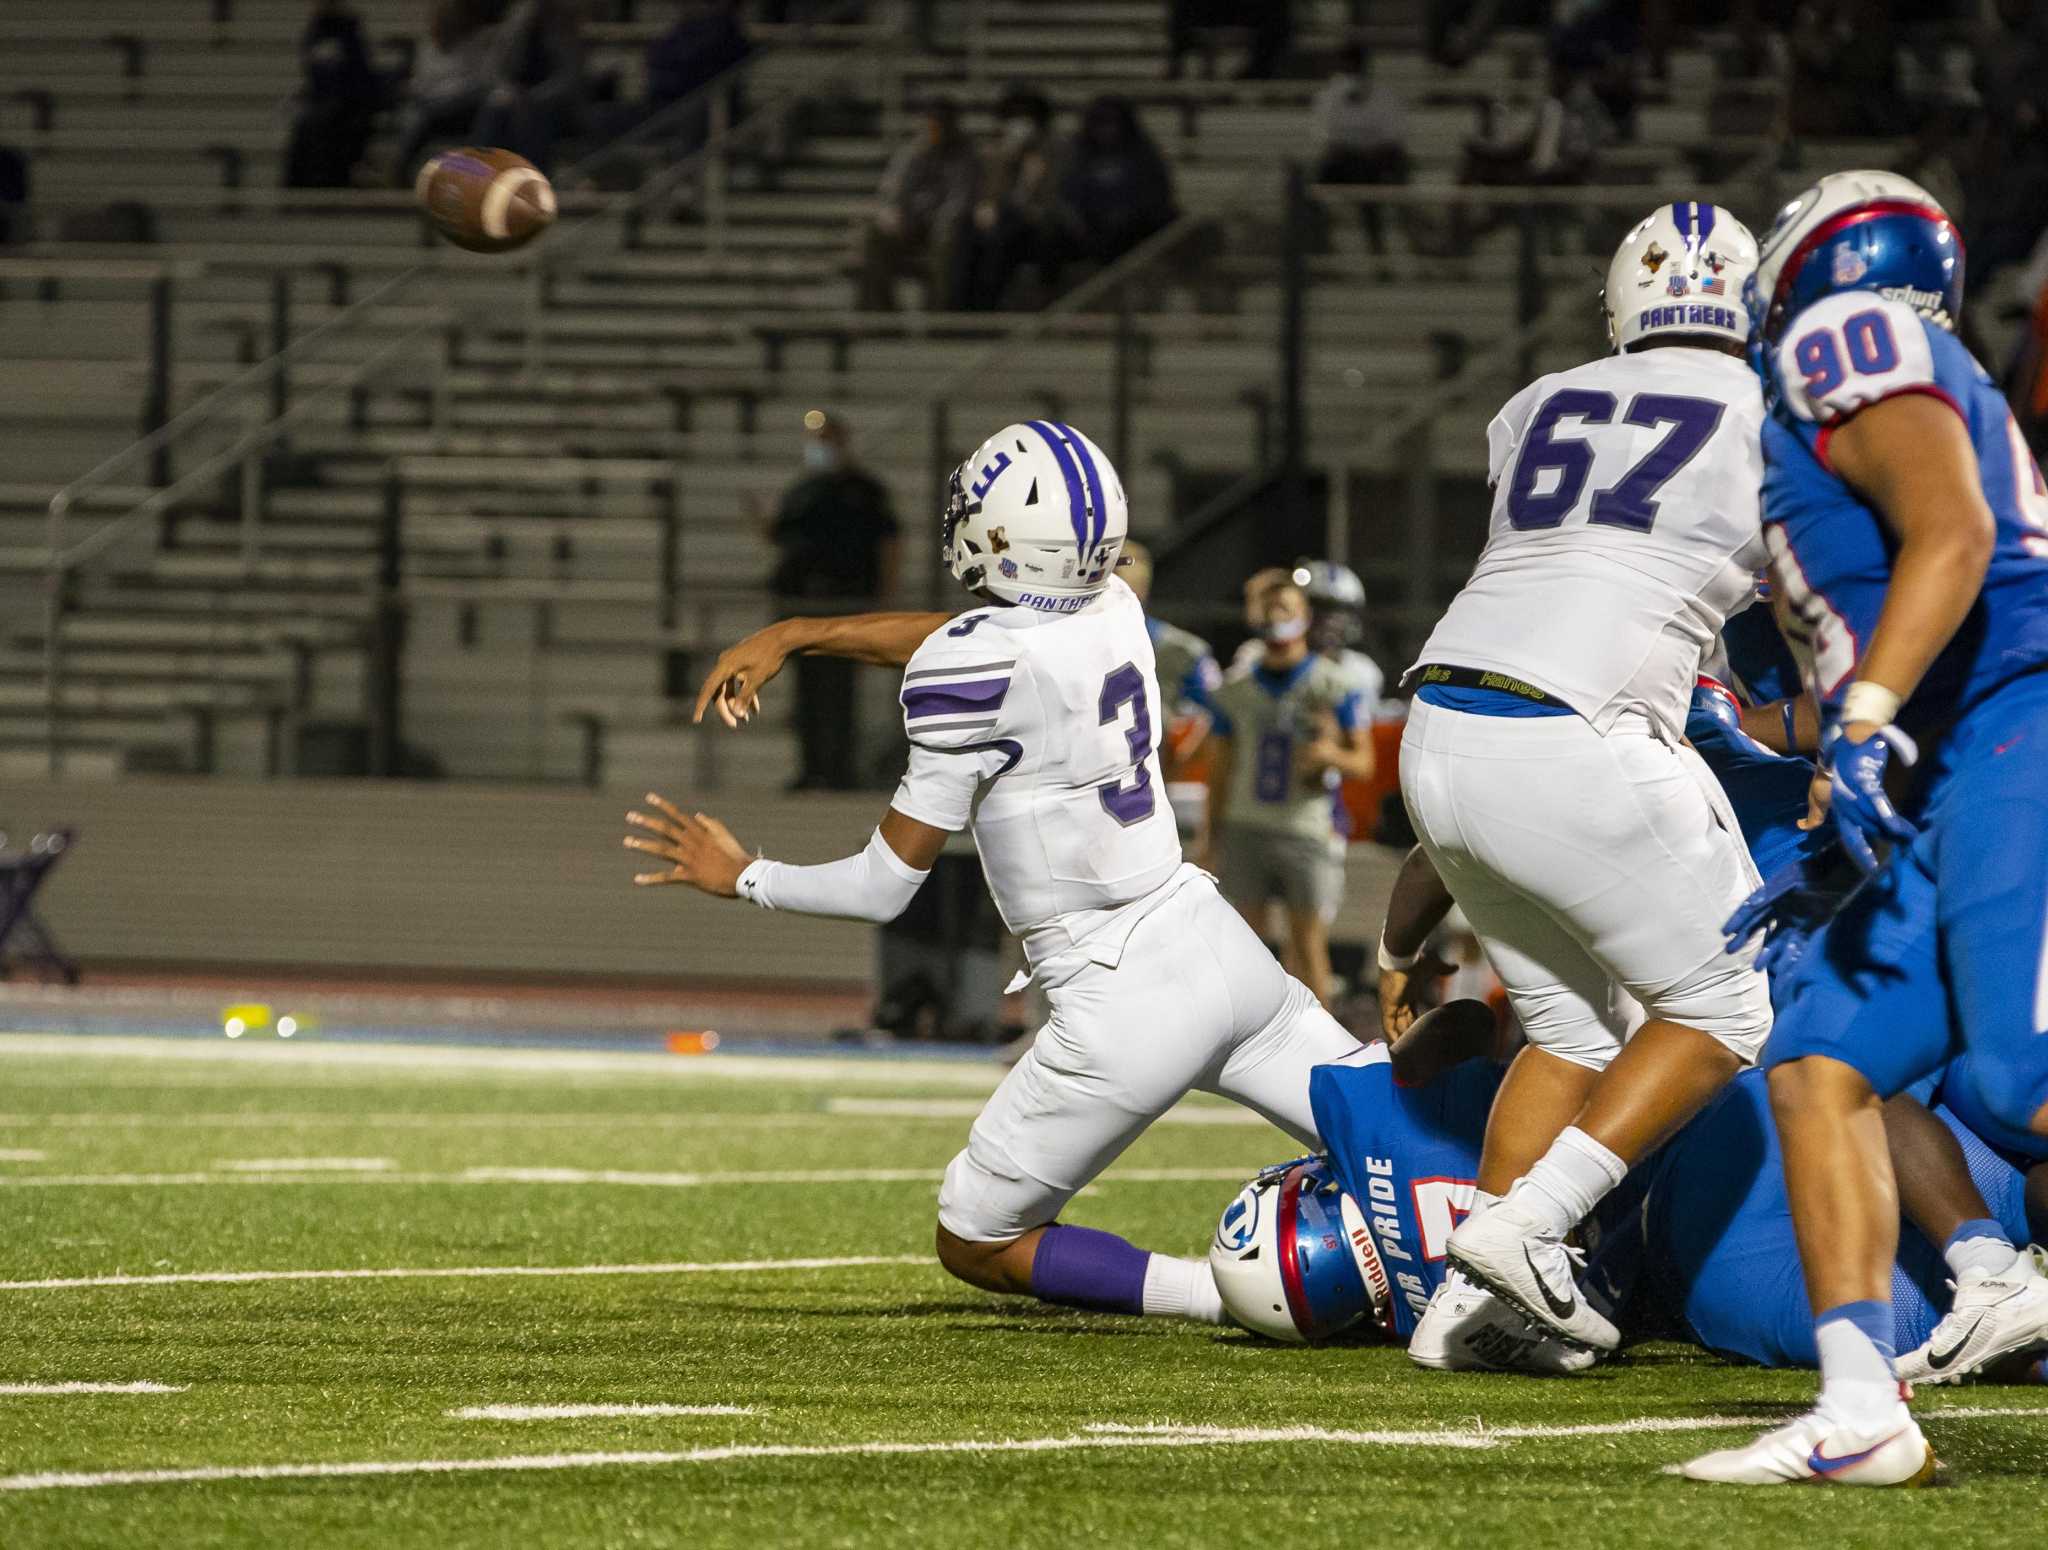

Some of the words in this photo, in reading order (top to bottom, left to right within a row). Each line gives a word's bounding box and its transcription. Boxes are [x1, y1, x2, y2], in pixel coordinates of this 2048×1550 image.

[1640, 304, 1736, 331] PANTHERS
[1795, 309, 1901, 399] 90
[1508, 387, 1728, 534] 67
[1098, 660, 1156, 829] 3
[1366, 1156, 1412, 1261] PRIDE
[1351, 1227, 1393, 1300] Riddell
